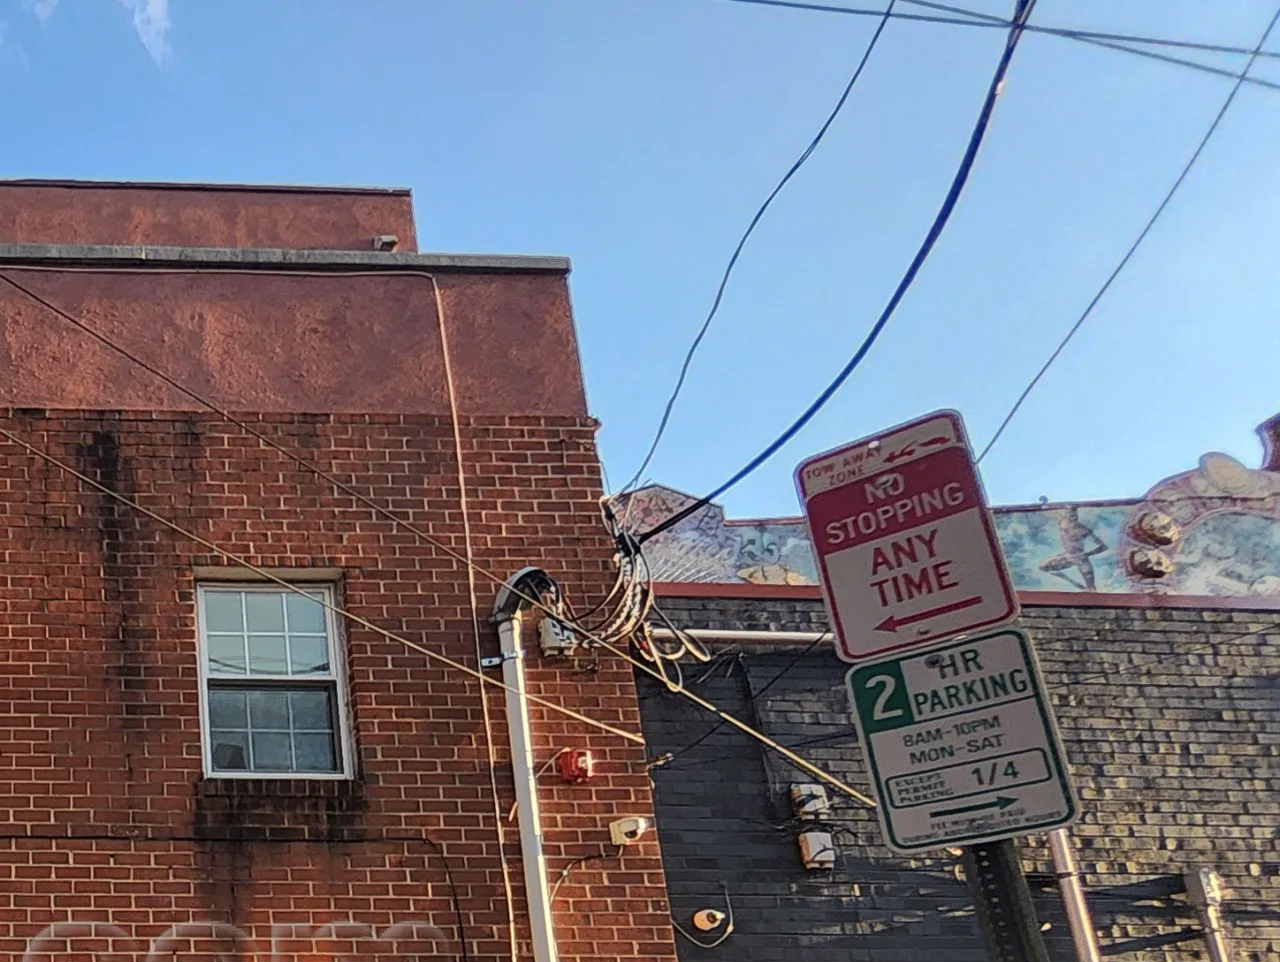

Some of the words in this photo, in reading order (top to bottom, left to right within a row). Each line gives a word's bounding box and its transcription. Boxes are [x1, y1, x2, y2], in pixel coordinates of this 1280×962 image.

[805, 463, 836, 480] TOW
[842, 447, 883, 468] AWAY
[829, 466, 866, 487] ZONE
[864, 472, 905, 504] NO
[826, 482, 964, 544] STOPPING
[871, 528, 938, 576] ANY
[870, 560, 960, 607] TIME
[865, 674, 904, 721] 2
[938, 649, 984, 680] HR
[913, 669, 1028, 716] PARKING
[902, 715, 1001, 748] 8AM-10PM
[909, 733, 1005, 765] MON-SAT
[971, 761, 1020, 786] 1/4
